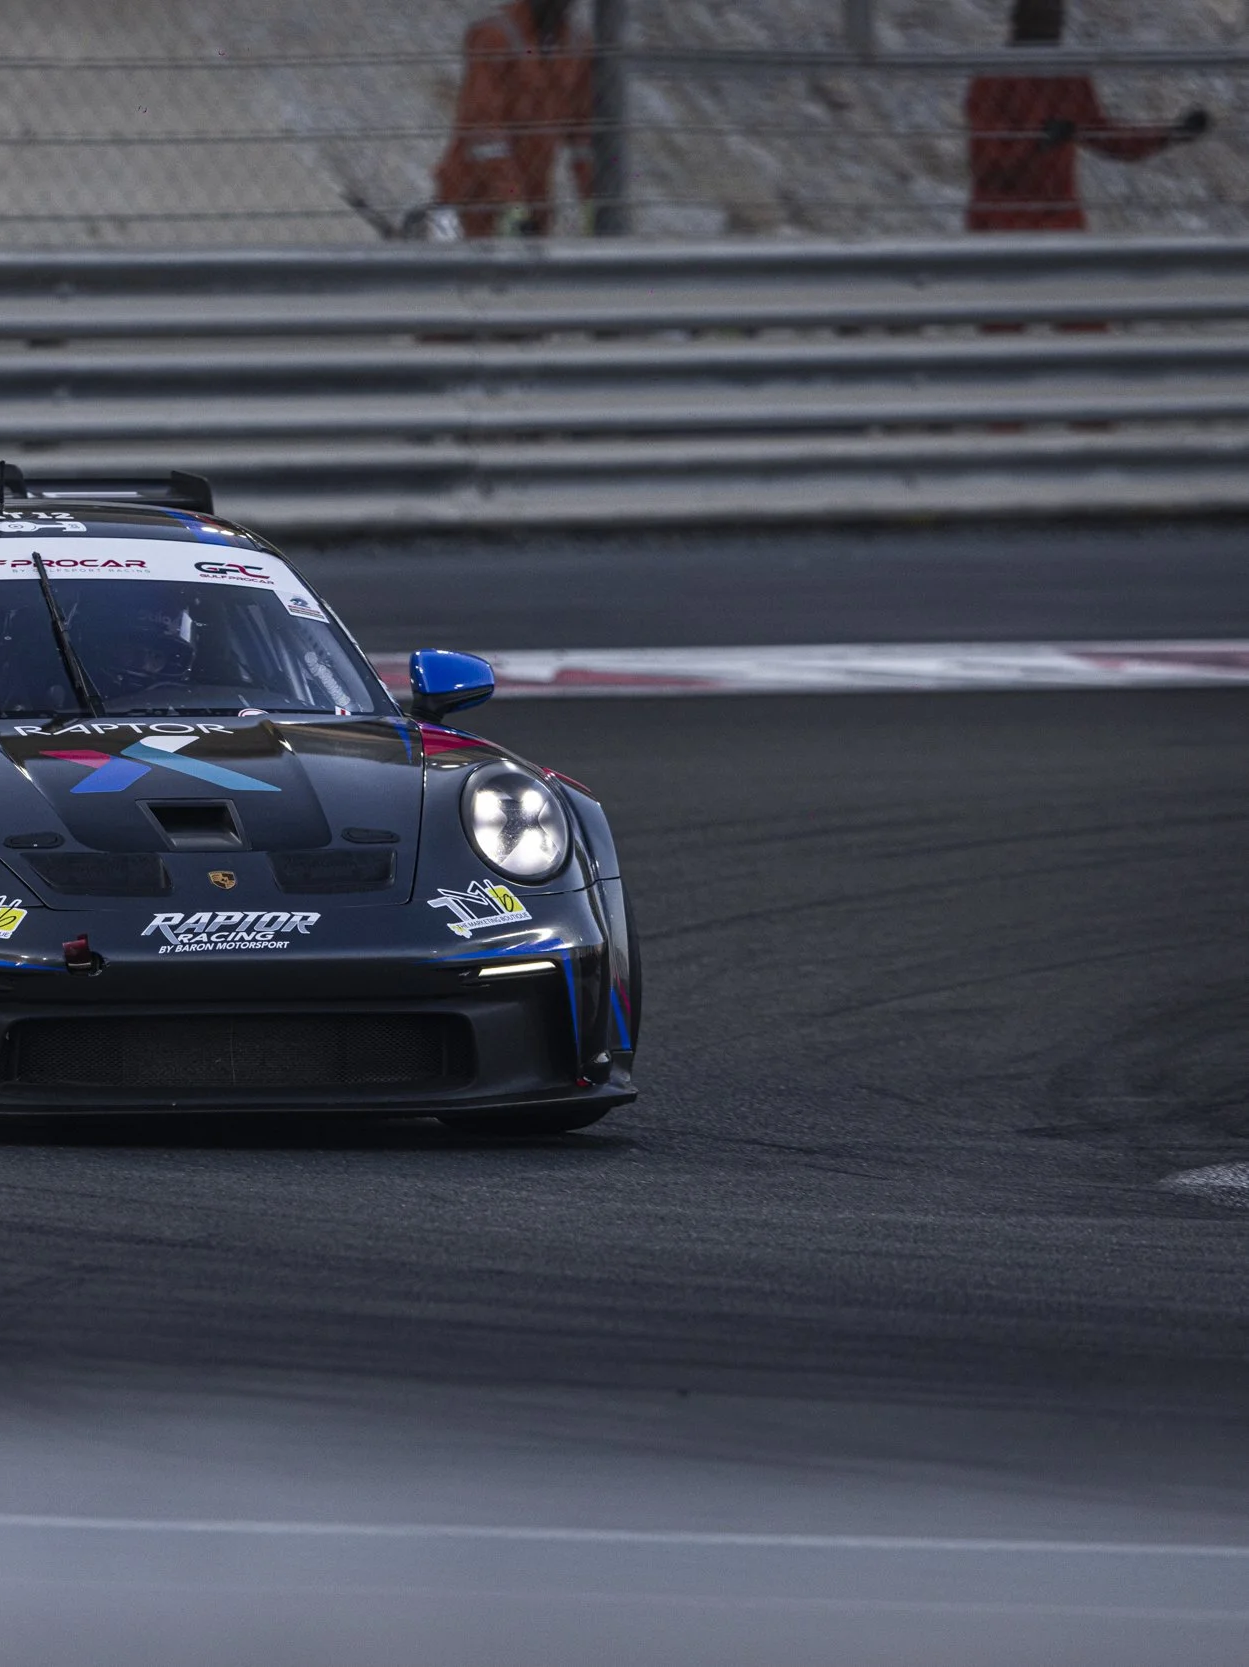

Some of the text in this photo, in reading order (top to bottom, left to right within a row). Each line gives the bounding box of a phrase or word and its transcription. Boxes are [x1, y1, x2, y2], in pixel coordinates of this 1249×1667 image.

[14, 723, 234, 736] RAPTOR
[141, 911, 321, 944] RAPTOR
[177, 931, 275, 943] RACING
[158, 941, 290, 954] BY BARON MOTORSPORT
